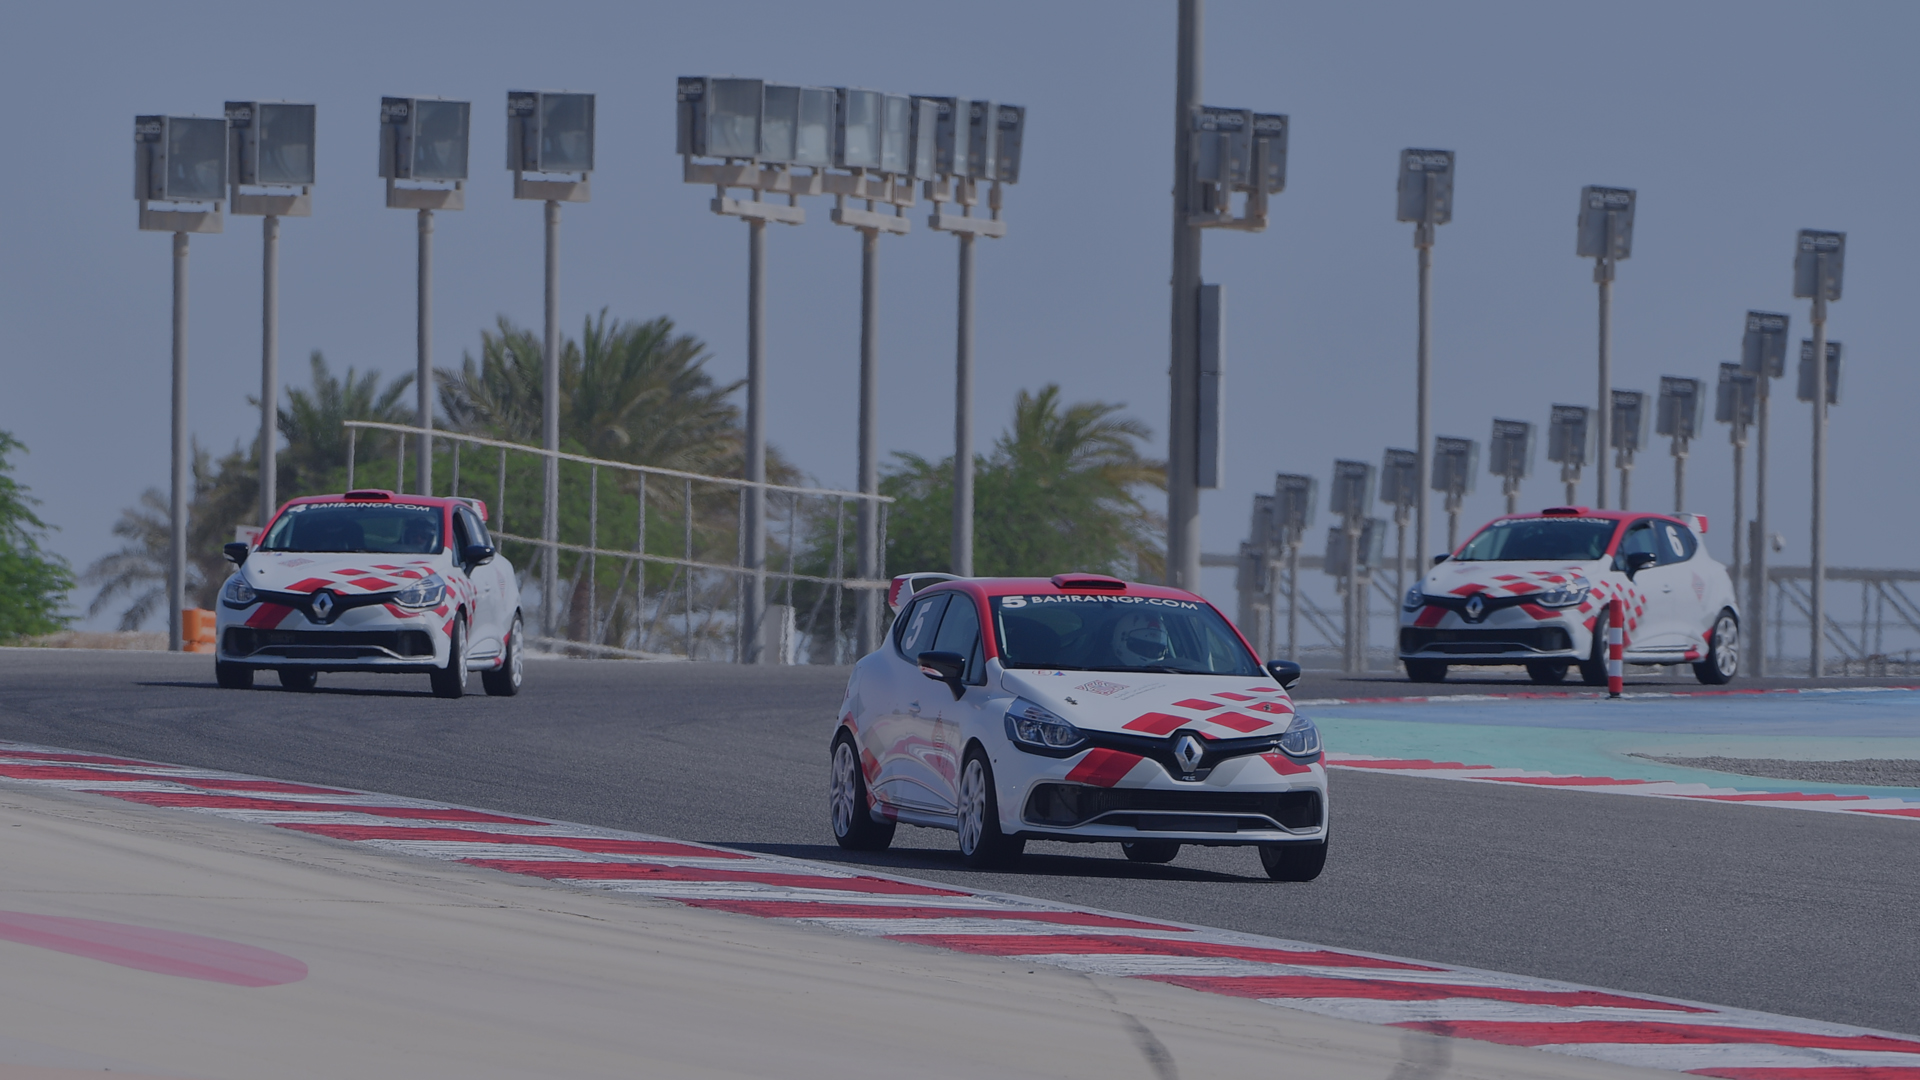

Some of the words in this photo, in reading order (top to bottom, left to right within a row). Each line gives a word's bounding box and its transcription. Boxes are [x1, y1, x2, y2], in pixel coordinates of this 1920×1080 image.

[1665, 525, 1684, 558] 6
[1002, 595, 1028, 609] 5
[1031, 595, 1198, 611] BAHRAINGP.COM
[905, 601, 933, 651] 5
